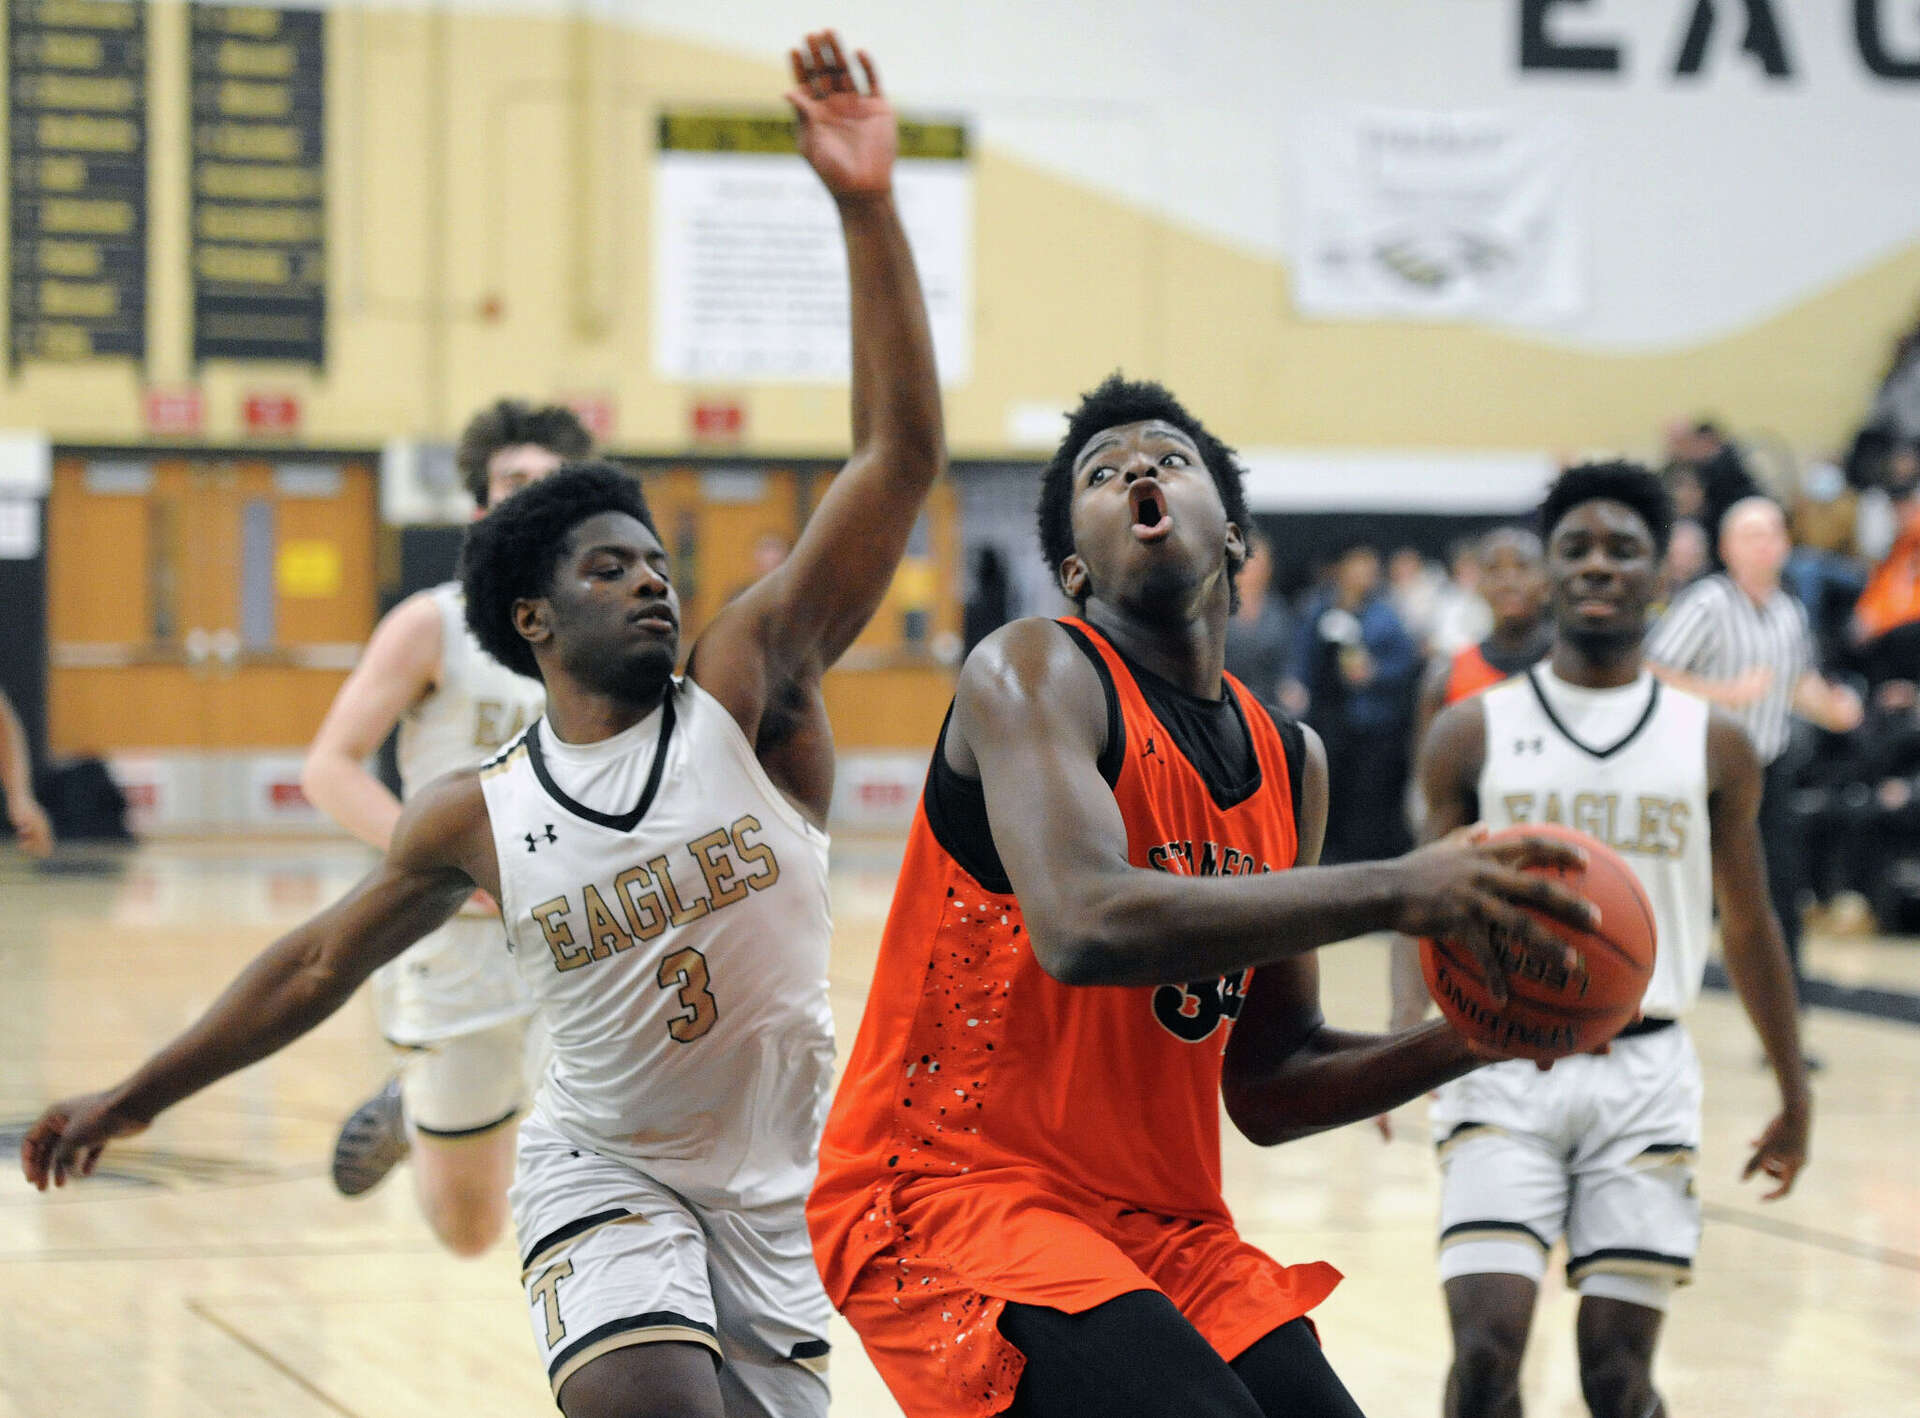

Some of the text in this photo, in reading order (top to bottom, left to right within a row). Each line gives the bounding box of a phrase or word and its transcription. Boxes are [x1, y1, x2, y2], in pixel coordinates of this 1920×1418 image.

[531, 814, 780, 973] EAGLES
[656, 946, 719, 1043] 3
[531, 1257, 574, 1351] T
